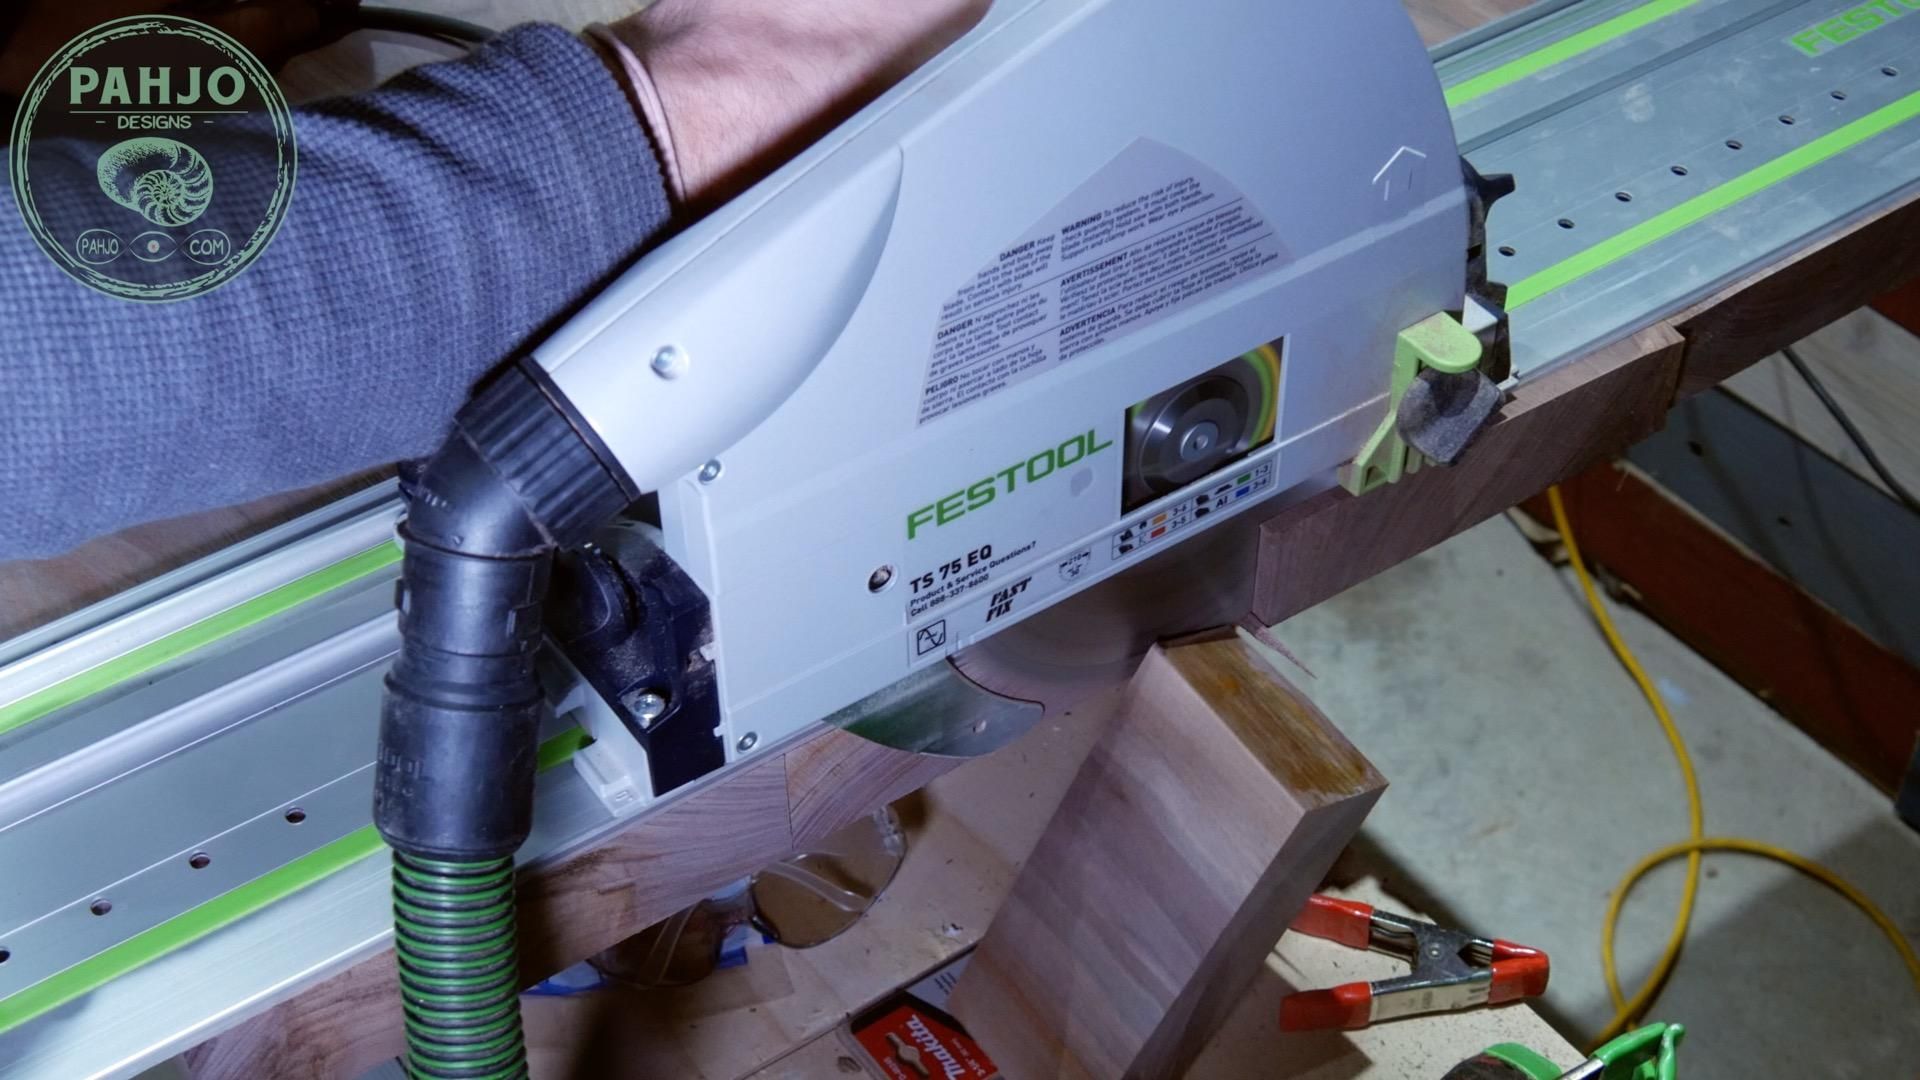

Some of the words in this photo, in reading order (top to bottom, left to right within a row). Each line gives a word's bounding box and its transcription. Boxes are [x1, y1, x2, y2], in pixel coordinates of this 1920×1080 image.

[1061, 212, 1101, 235] WARNING
[1000, 240, 1034, 262] DANGER
[1060, 251, 1127, 287] AVERTISSEMENT
[937, 318, 972, 340] DANGER
[1060, 306, 1115, 336] ADVERTENCIA
[925, 375, 958, 395] PELIGRO
[907, 428, 1113, 540] FESTOOL
[910, 571, 934, 595] TS
[939, 557, 961, 581] 75
[967, 543, 991, 568] EQ
[910, 584, 944, 607] Product
[946, 580, 953, 590] &
[956, 564, 986, 585] Service
[990, 540, 1036, 569] Questions?
[990, 577, 1031, 606] FAST
[911, 601, 928, 616] Call
[986, 599, 1012, 622] FIX
